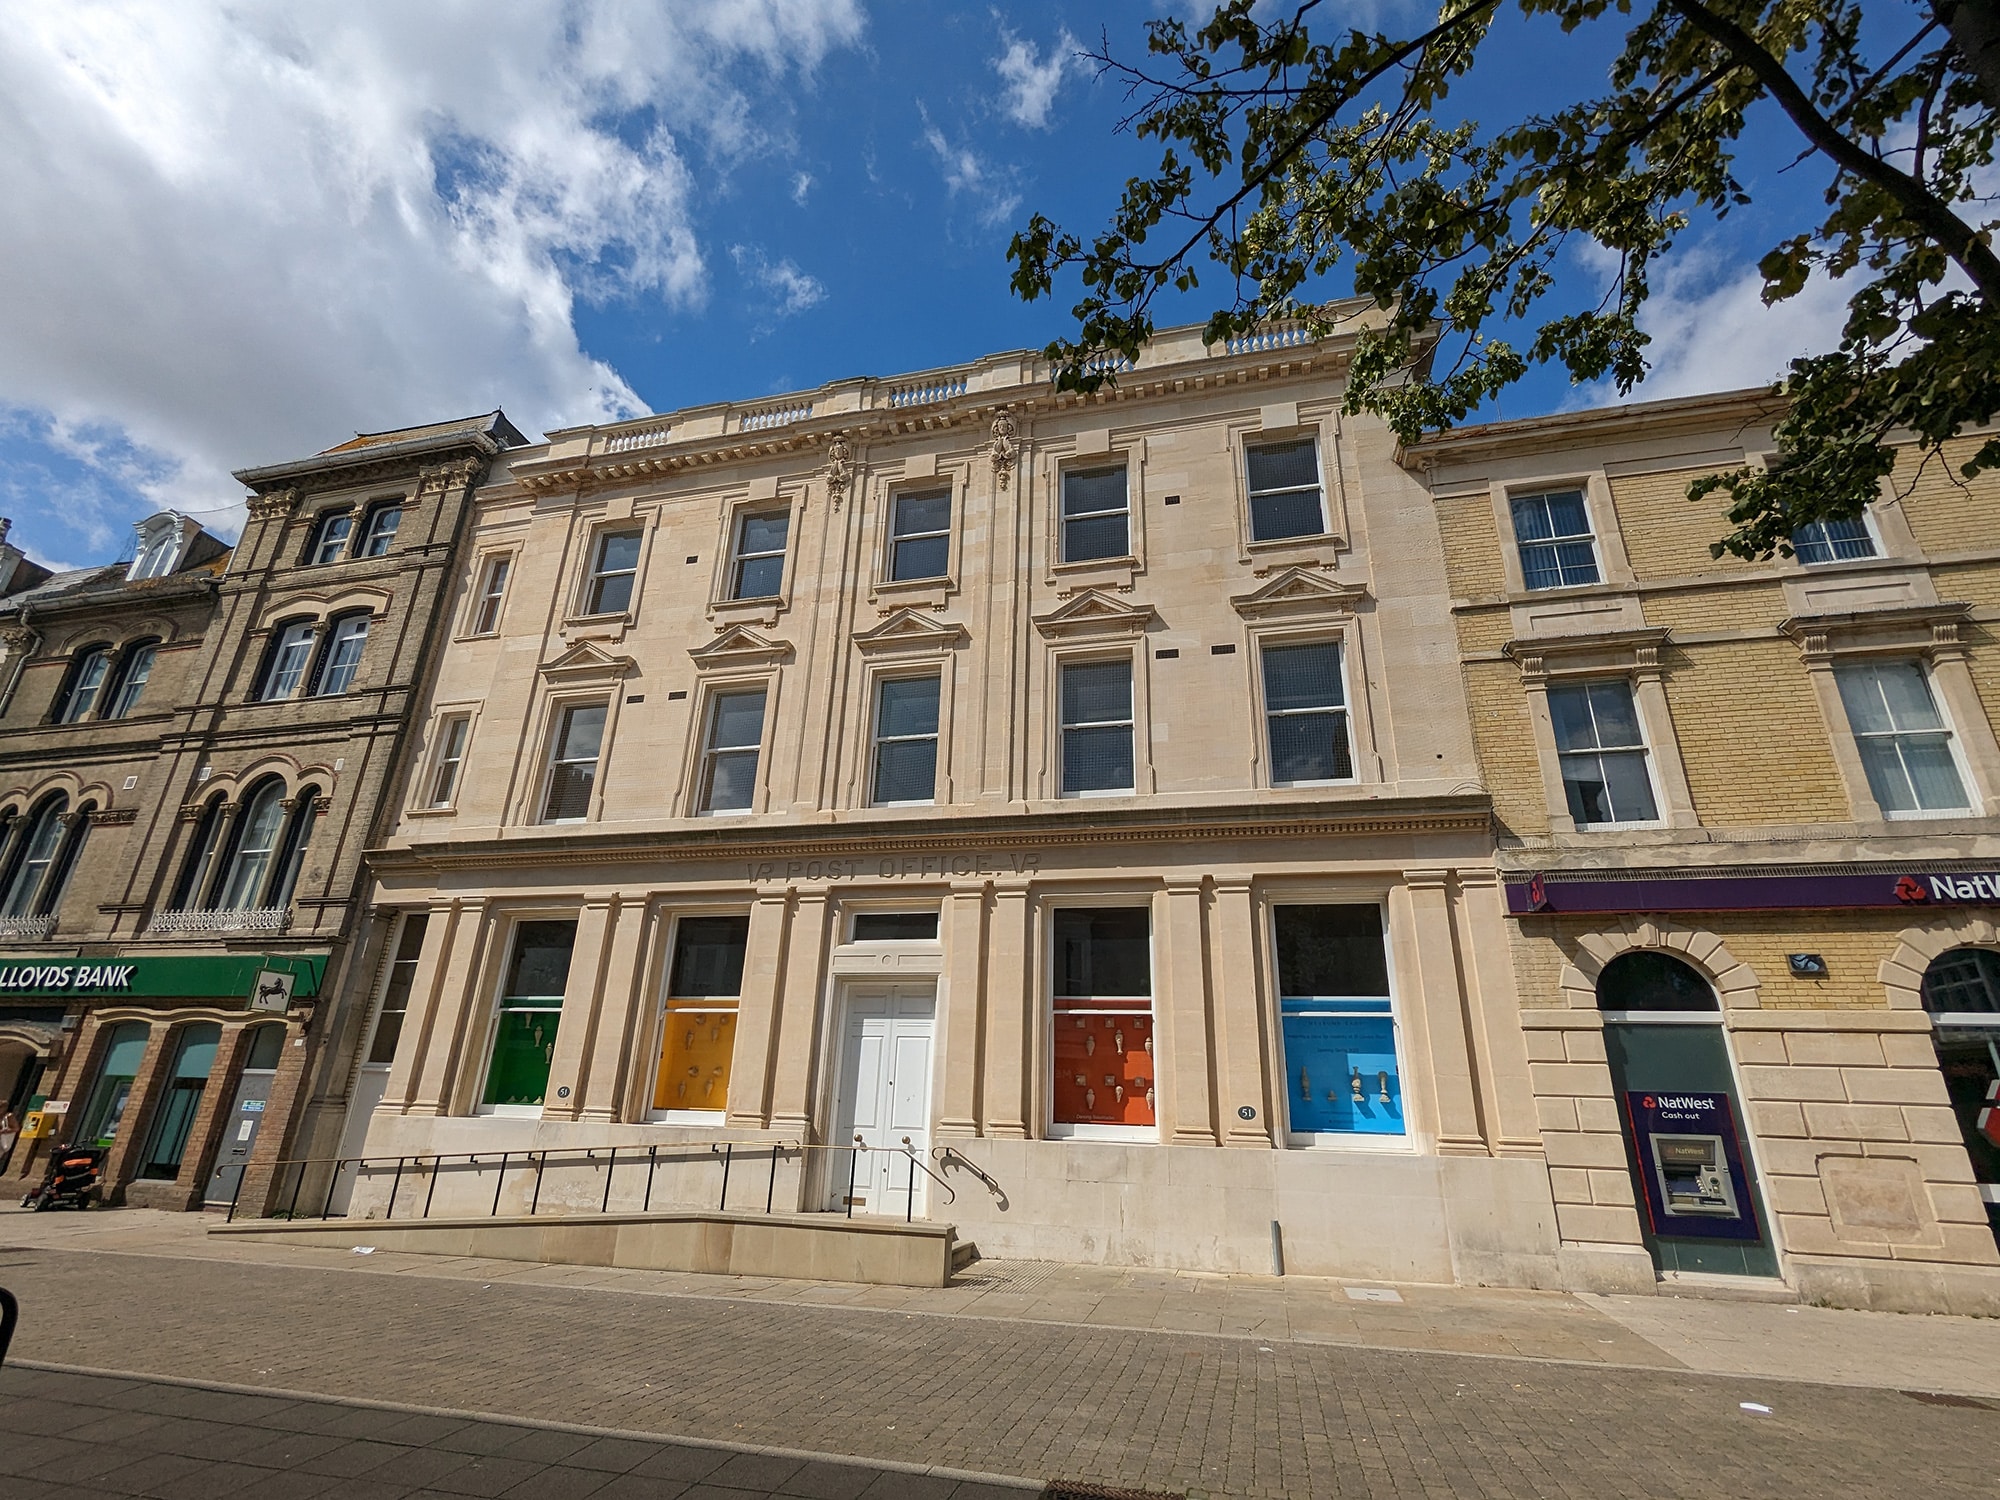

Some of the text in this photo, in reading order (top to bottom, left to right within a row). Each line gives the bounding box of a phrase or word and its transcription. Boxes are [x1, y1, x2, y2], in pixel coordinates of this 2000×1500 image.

[785, 859, 865, 883] POST
[0, 965, 134, 987] LLOYDS BANK
[560, 1088, 569, 1097] 51
[1657, 1096, 1716, 1110] NatWest
[1241, 1108, 1252, 1118] 51
[1661, 1111, 1700, 1120] Cash out
[1675, 1147, 1705, 1155] NatWest
